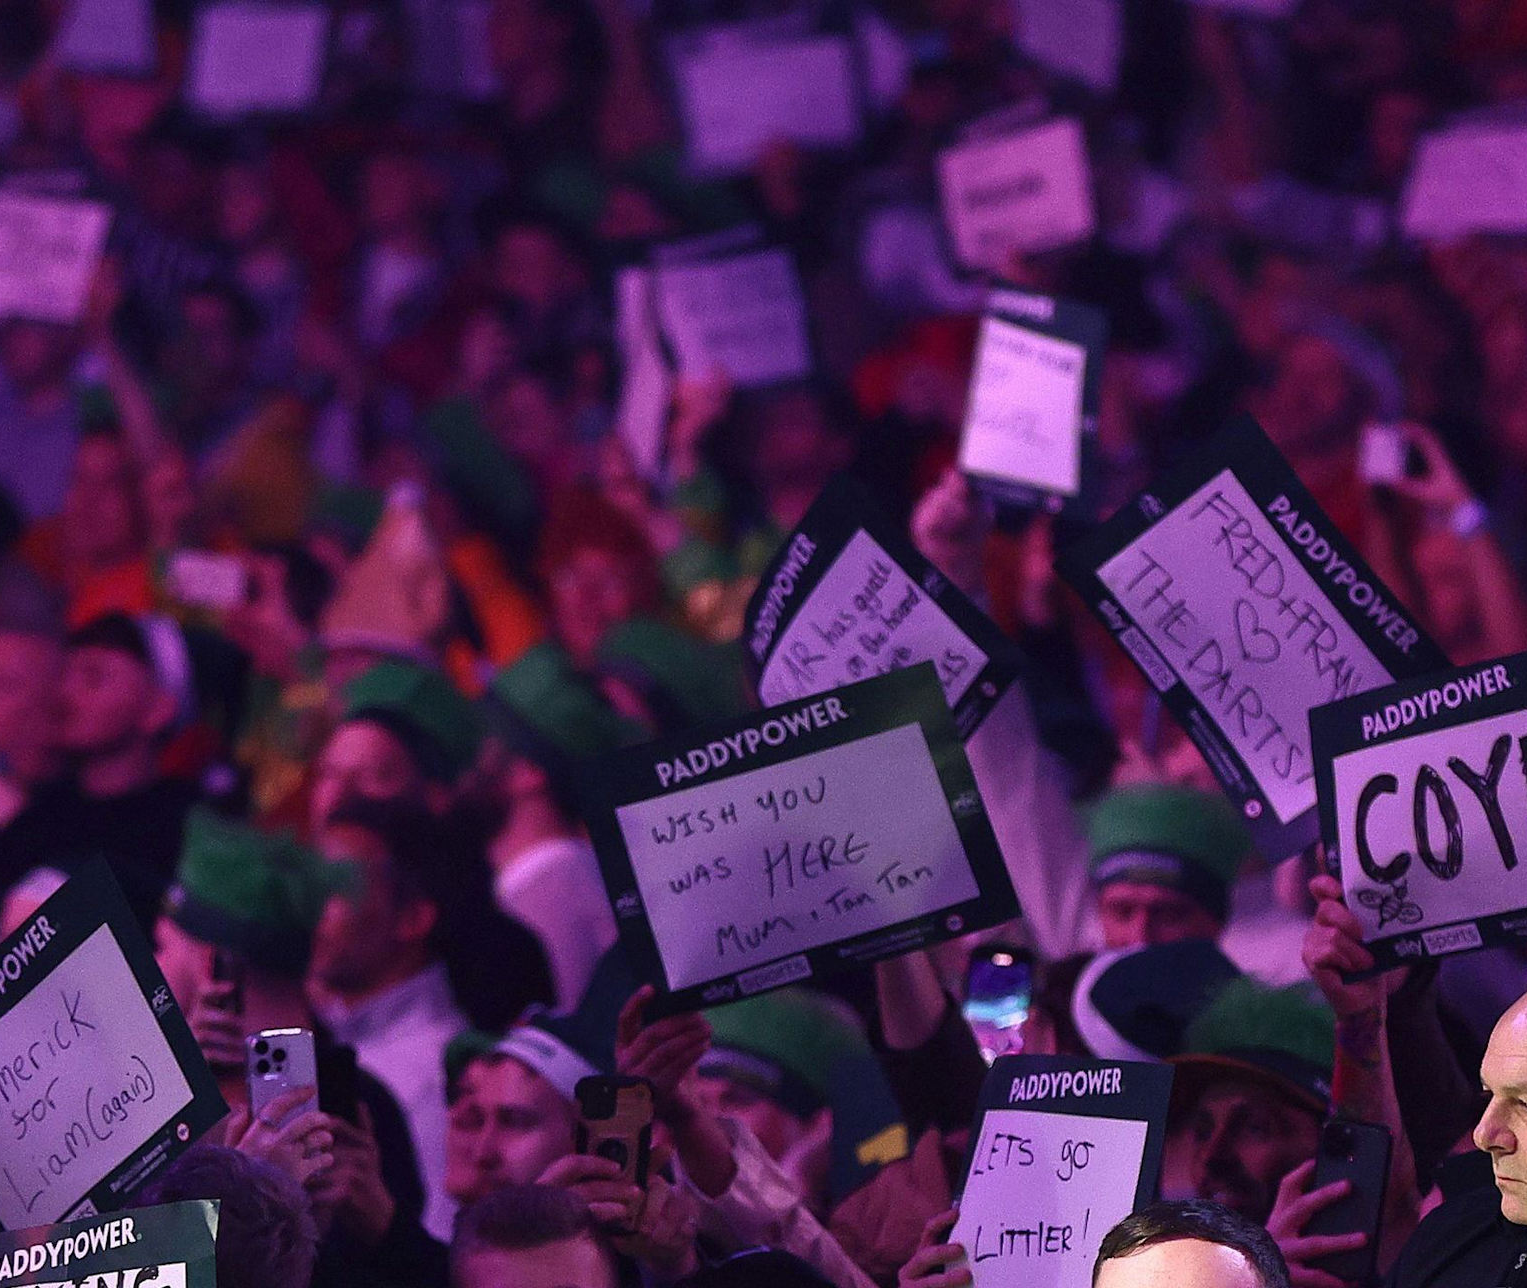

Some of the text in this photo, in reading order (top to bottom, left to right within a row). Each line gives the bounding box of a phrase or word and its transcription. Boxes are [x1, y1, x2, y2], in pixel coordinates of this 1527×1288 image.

[1127, 551, 1198, 650] THE
[1269, 494, 1418, 653] PADDYPOWER
[1363, 664, 1512, 741] PADDYPOWER
[656, 696, 848, 788] PADDYPOWER
[652, 803, 738, 845] WISH
[669, 831, 870, 898] WAS HERE
[715, 914, 795, 957] Mum
[12, 1077, 60, 1140] for
[1008, 1067, 1122, 1103] PADDYPOWER
[973, 1131, 1035, 1175] LETS
